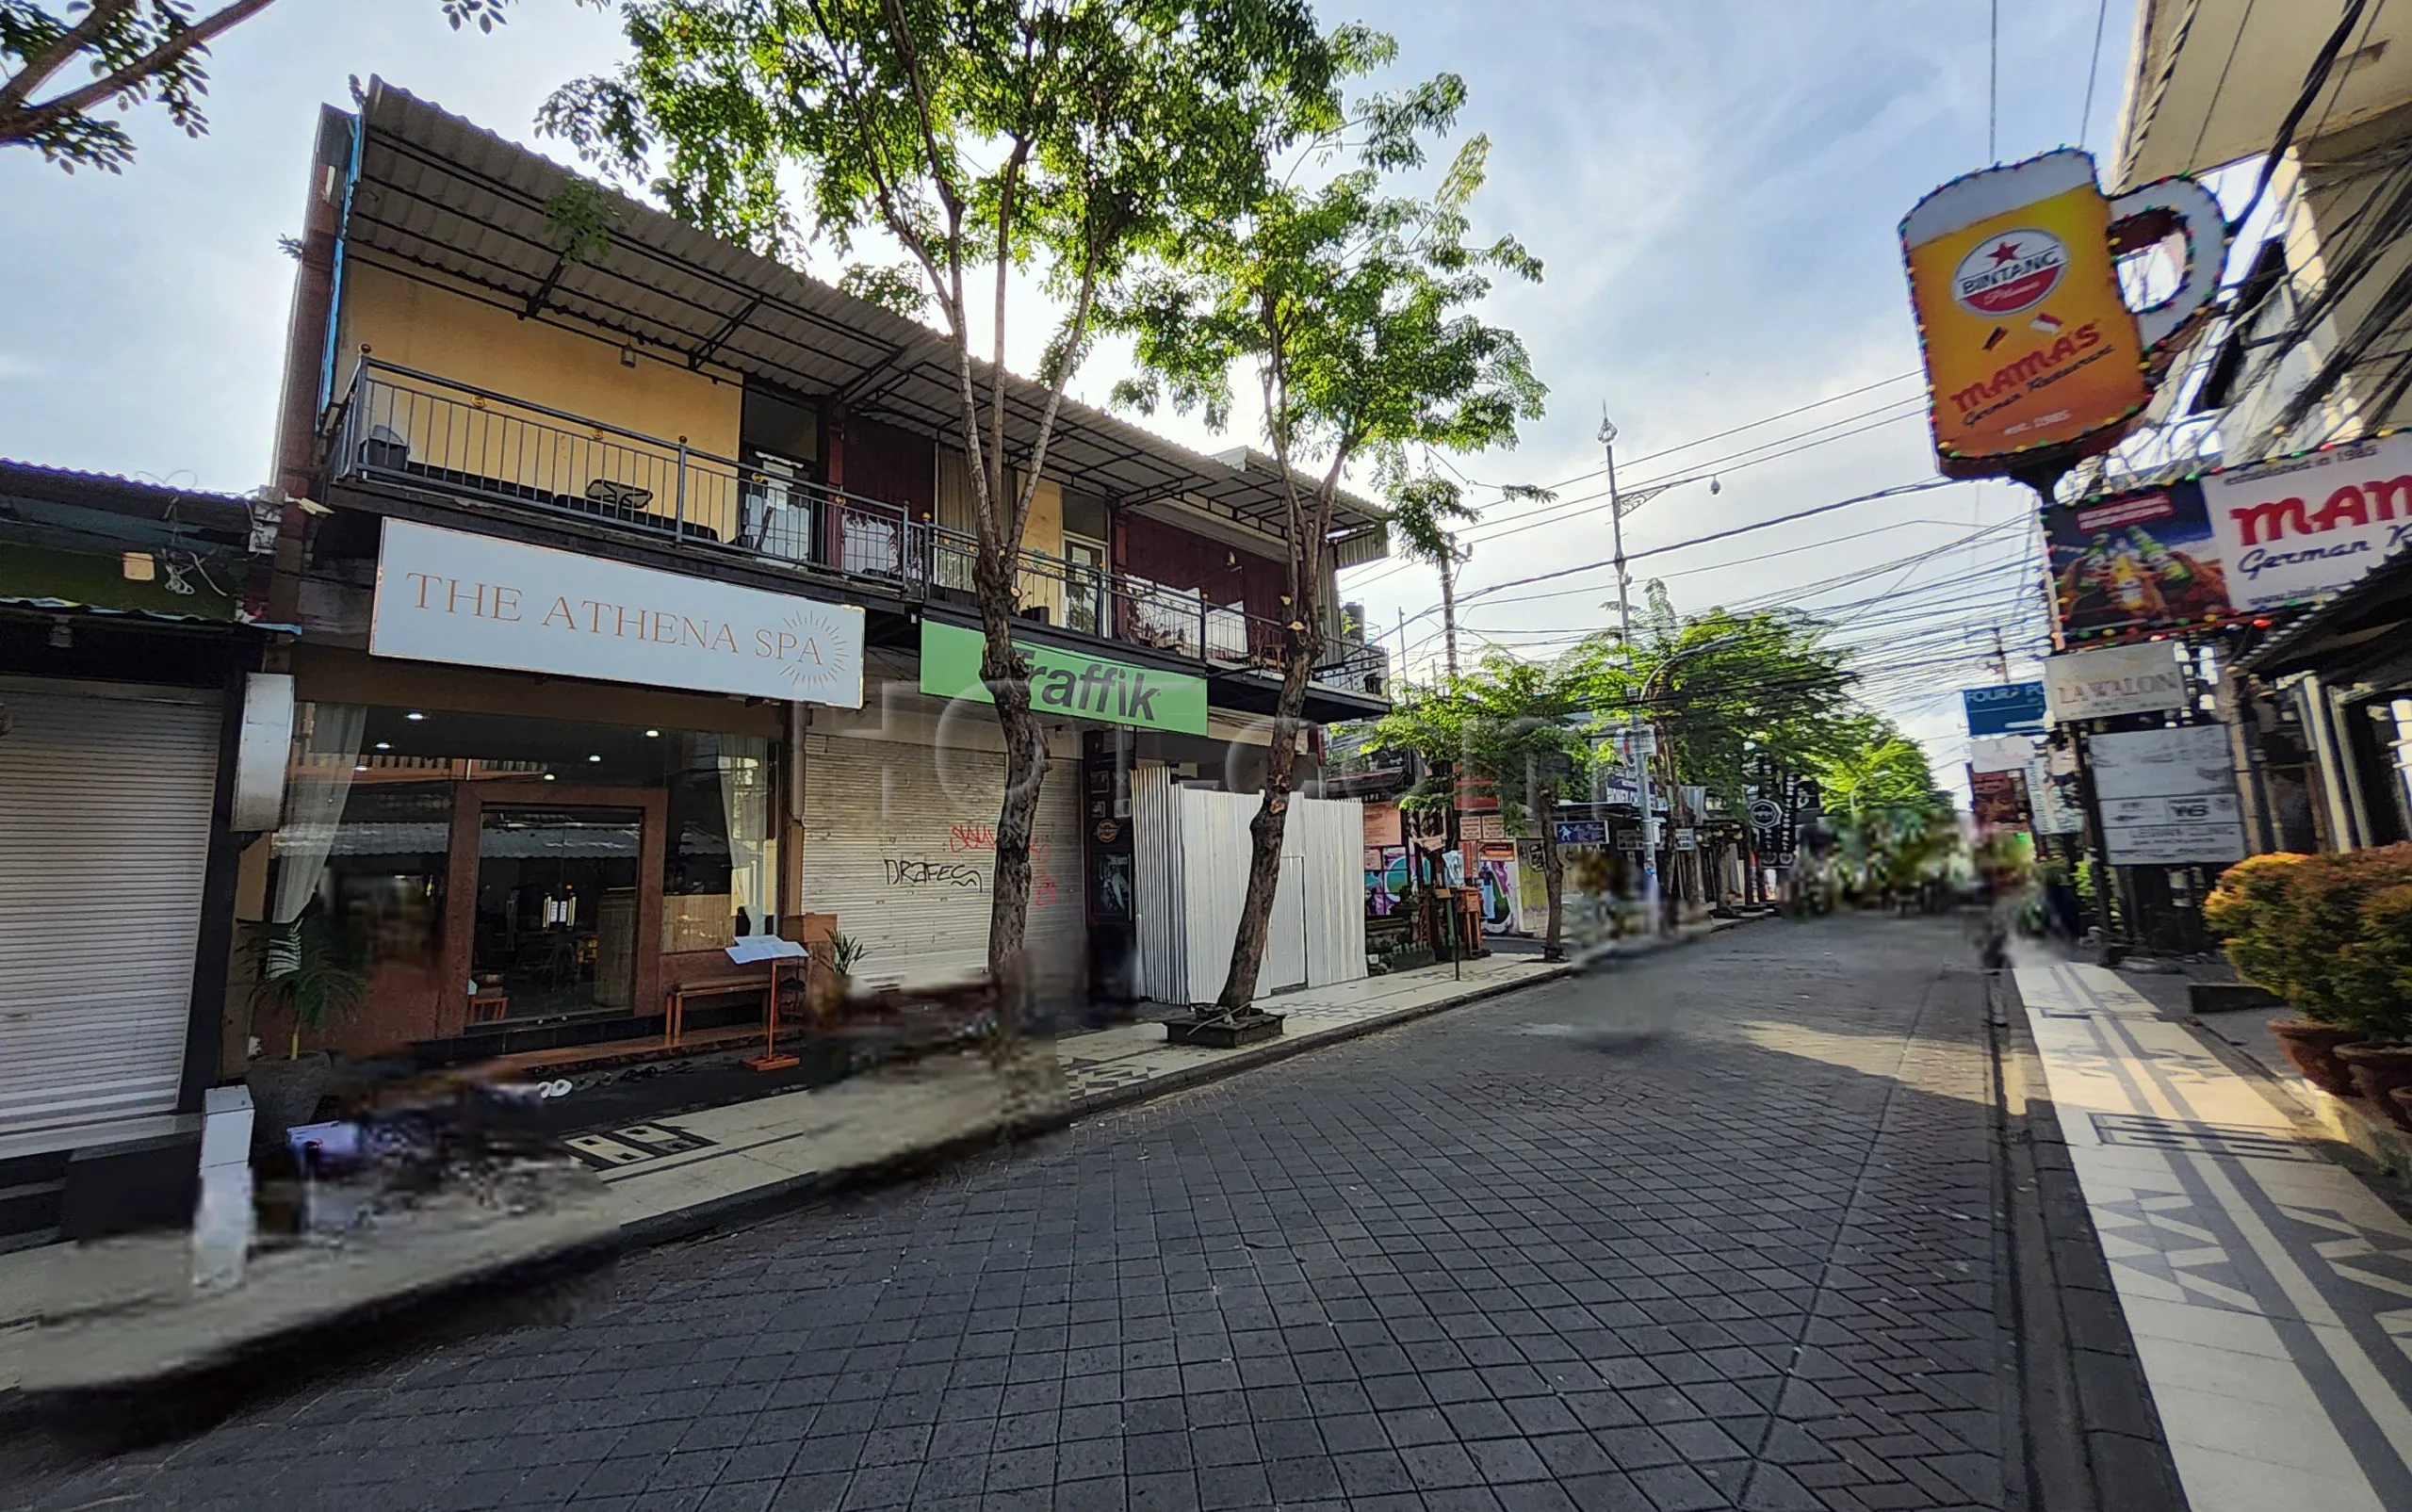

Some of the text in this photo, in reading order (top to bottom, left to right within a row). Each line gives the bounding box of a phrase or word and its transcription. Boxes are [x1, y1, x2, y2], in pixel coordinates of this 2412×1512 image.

[1962, 251, 2060, 295] BINTANG
[2238, 540, 2371, 580] German
[405, 572, 823, 666] THE ATHENA SPA
[1014, 647, 1160, 722] raffik
